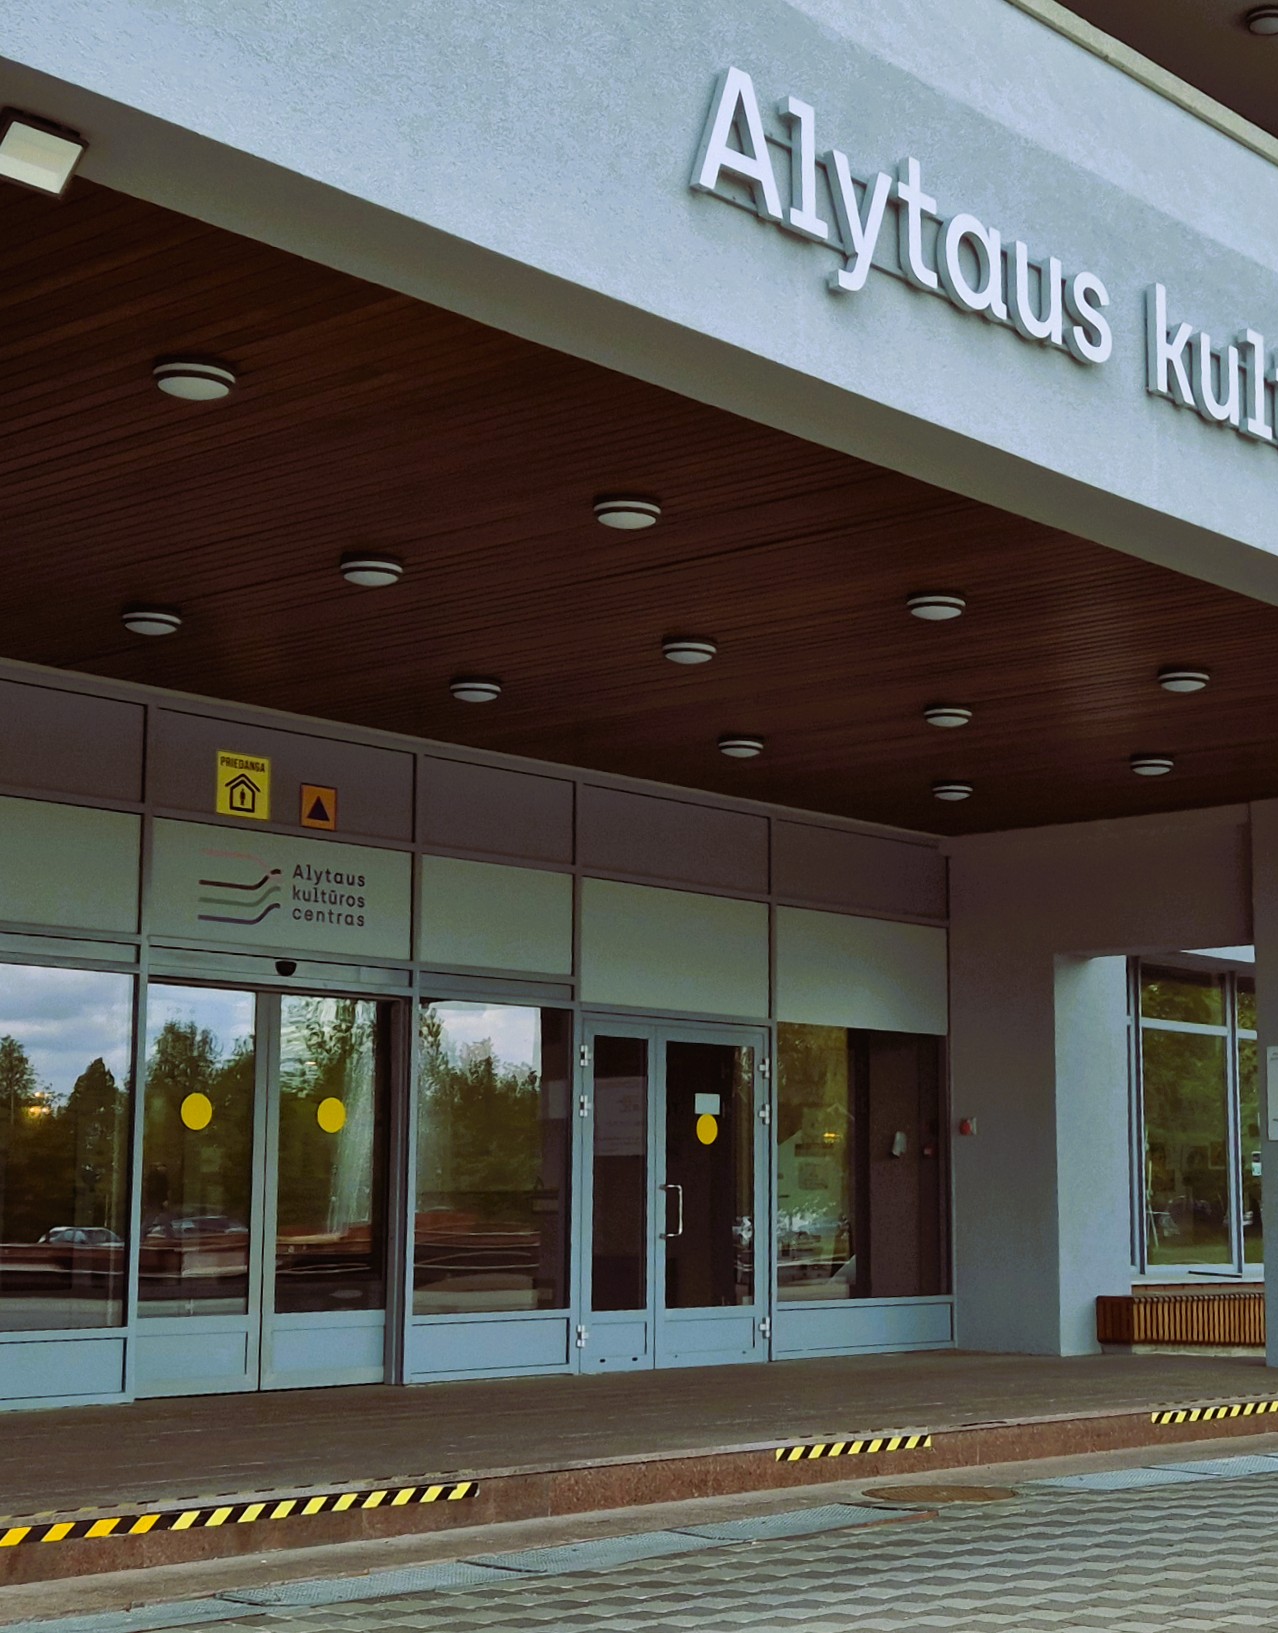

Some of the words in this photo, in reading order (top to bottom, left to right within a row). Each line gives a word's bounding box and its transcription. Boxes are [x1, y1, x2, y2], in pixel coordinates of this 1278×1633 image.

[690, 65, 1113, 366] Alytaus
[292, 864, 366, 887] Alytaus
[292, 885, 366, 908] kultūros
[292, 907, 365, 927] centras
